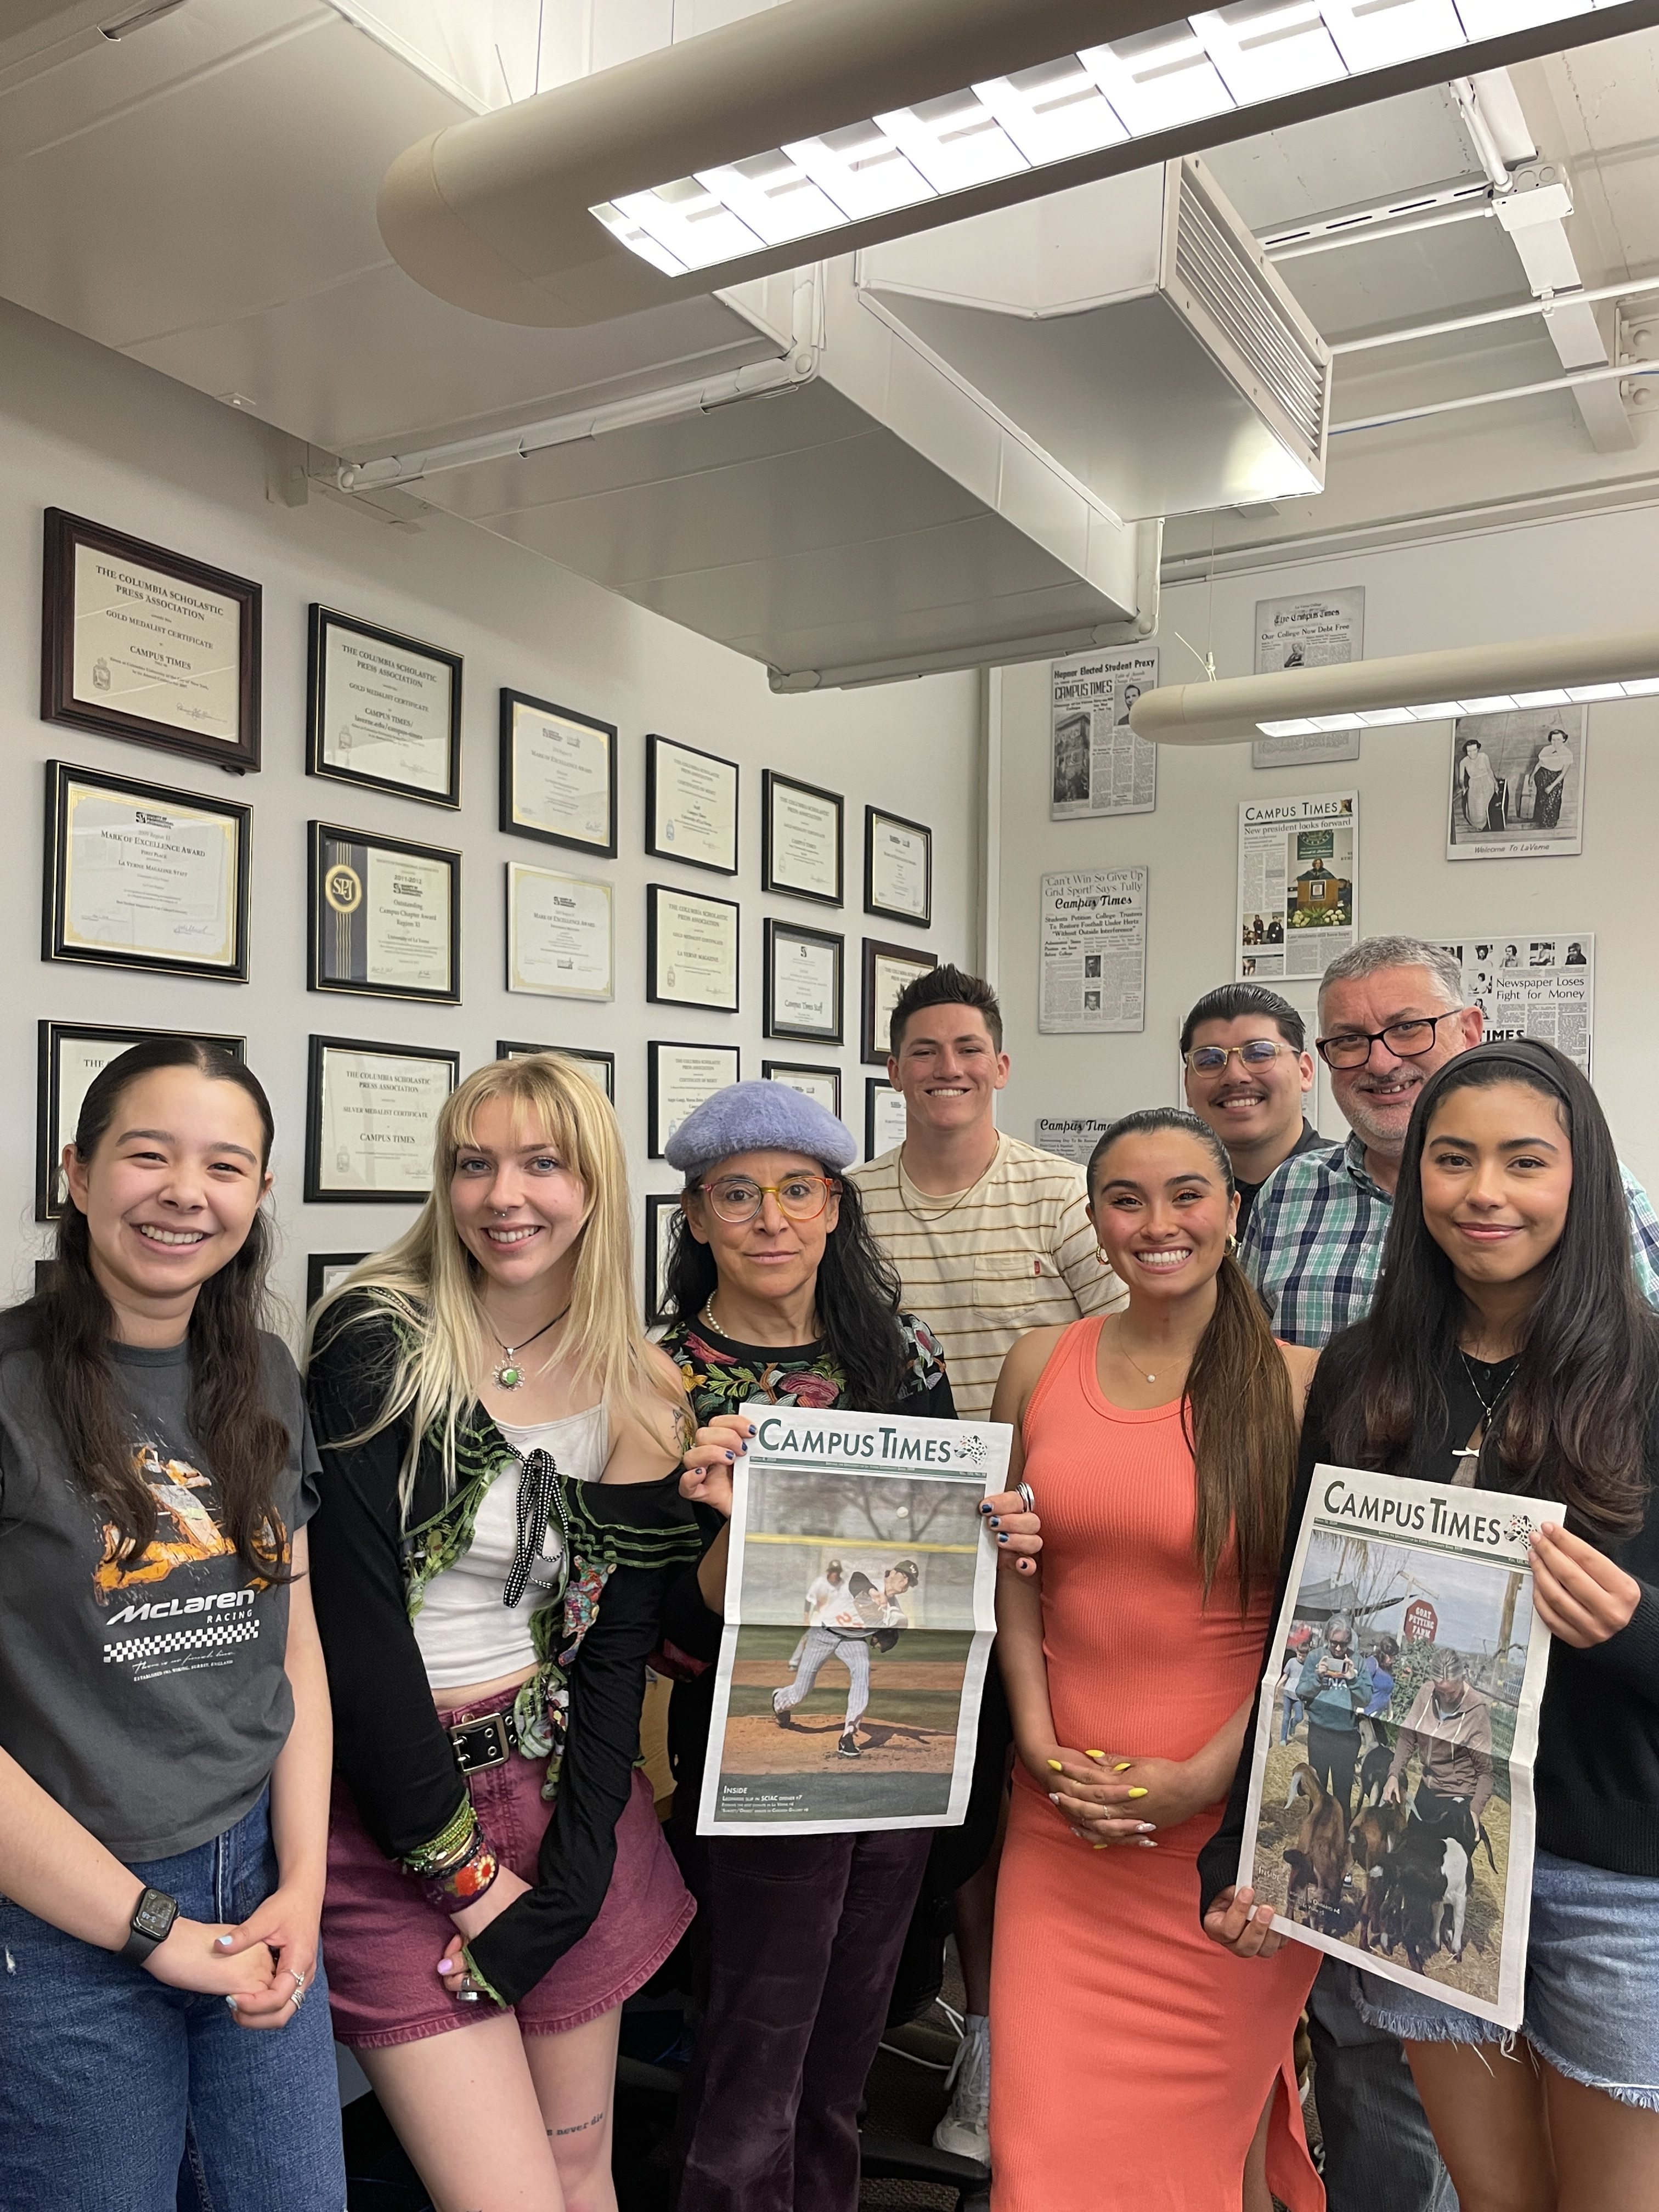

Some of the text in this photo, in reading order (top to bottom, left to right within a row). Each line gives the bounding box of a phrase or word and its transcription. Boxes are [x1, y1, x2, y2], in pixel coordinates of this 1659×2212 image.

[96, 566, 223, 616] THE COLUMBIA SCHOLASTIC
[116, 585, 144, 600] PRESS
[145, 595, 205, 621] ASSOCIATION
[106, 610, 127, 622] GOLD
[129, 617, 166, 634] MEDALIST
[168, 630, 213, 649] CERTIFICATE
[130, 646, 164, 662] CAMPUS
[166, 656, 191, 670] TIMES
[342, 644, 437, 682] THE COLUMBIA SCHOLASTIC
[358, 661, 422, 687] PRESS ASSOCIATION
[1105, 662, 1131, 672] Student
[1055, 680, 1112, 700] CAMPUS TIMES
[394, 696, 428, 712] CERTIFICATE
[365, 708, 391, 720] CAMPUS
[1245, 802, 1338, 821] CAMPUS TIMES
[1263, 824, 1296, 834] president
[1299, 821, 1319, 830] looks
[1321, 818, 1351, 828] forward
[101, 831, 122, 842] MARK
[134, 837, 180, 853] EXCELLENCE
[182, 847, 205, 857] AWARD
[1073, 874, 1091, 883] Win
[1107, 871, 1128, 882] Give
[1131, 871, 1143, 880] Up
[333, 878, 353, 901] SPJ
[1045, 887, 1063, 897] Grid
[1096, 883, 1117, 894] Says
[1055, 895, 1132, 911] Campus Times
[1497, 977, 1584, 989] Newspaper Loses
[1497, 990, 1585, 1001] Fight for Money
[84, 1059, 104, 1068] THE
[360, 1073, 393, 1081] COLUMBIA
[394, 1076, 431, 1085] SCHOLASTIC
[380, 1084, 419, 1093] ASSOCIATION
[1041, 1119, 1082, 1133] Campus
[360, 1133, 415, 1143] CAMPUS TIMES
[759, 1418, 951, 1463] CAMPUS TIMES
[1324, 1481, 1501, 1545] CAMPUS TIMES
[106, 1589, 255, 1626] McLaren
[1415, 1607, 1431, 1619] GOAT
[207, 1609, 252, 1623] RACING
[1409, 1614, 1434, 1629] PETTING
[1412, 1625, 1431, 1639] FARM
[1259, 1866, 1280, 1883] INSIDE
[557, 2122, 589, 2135] never
